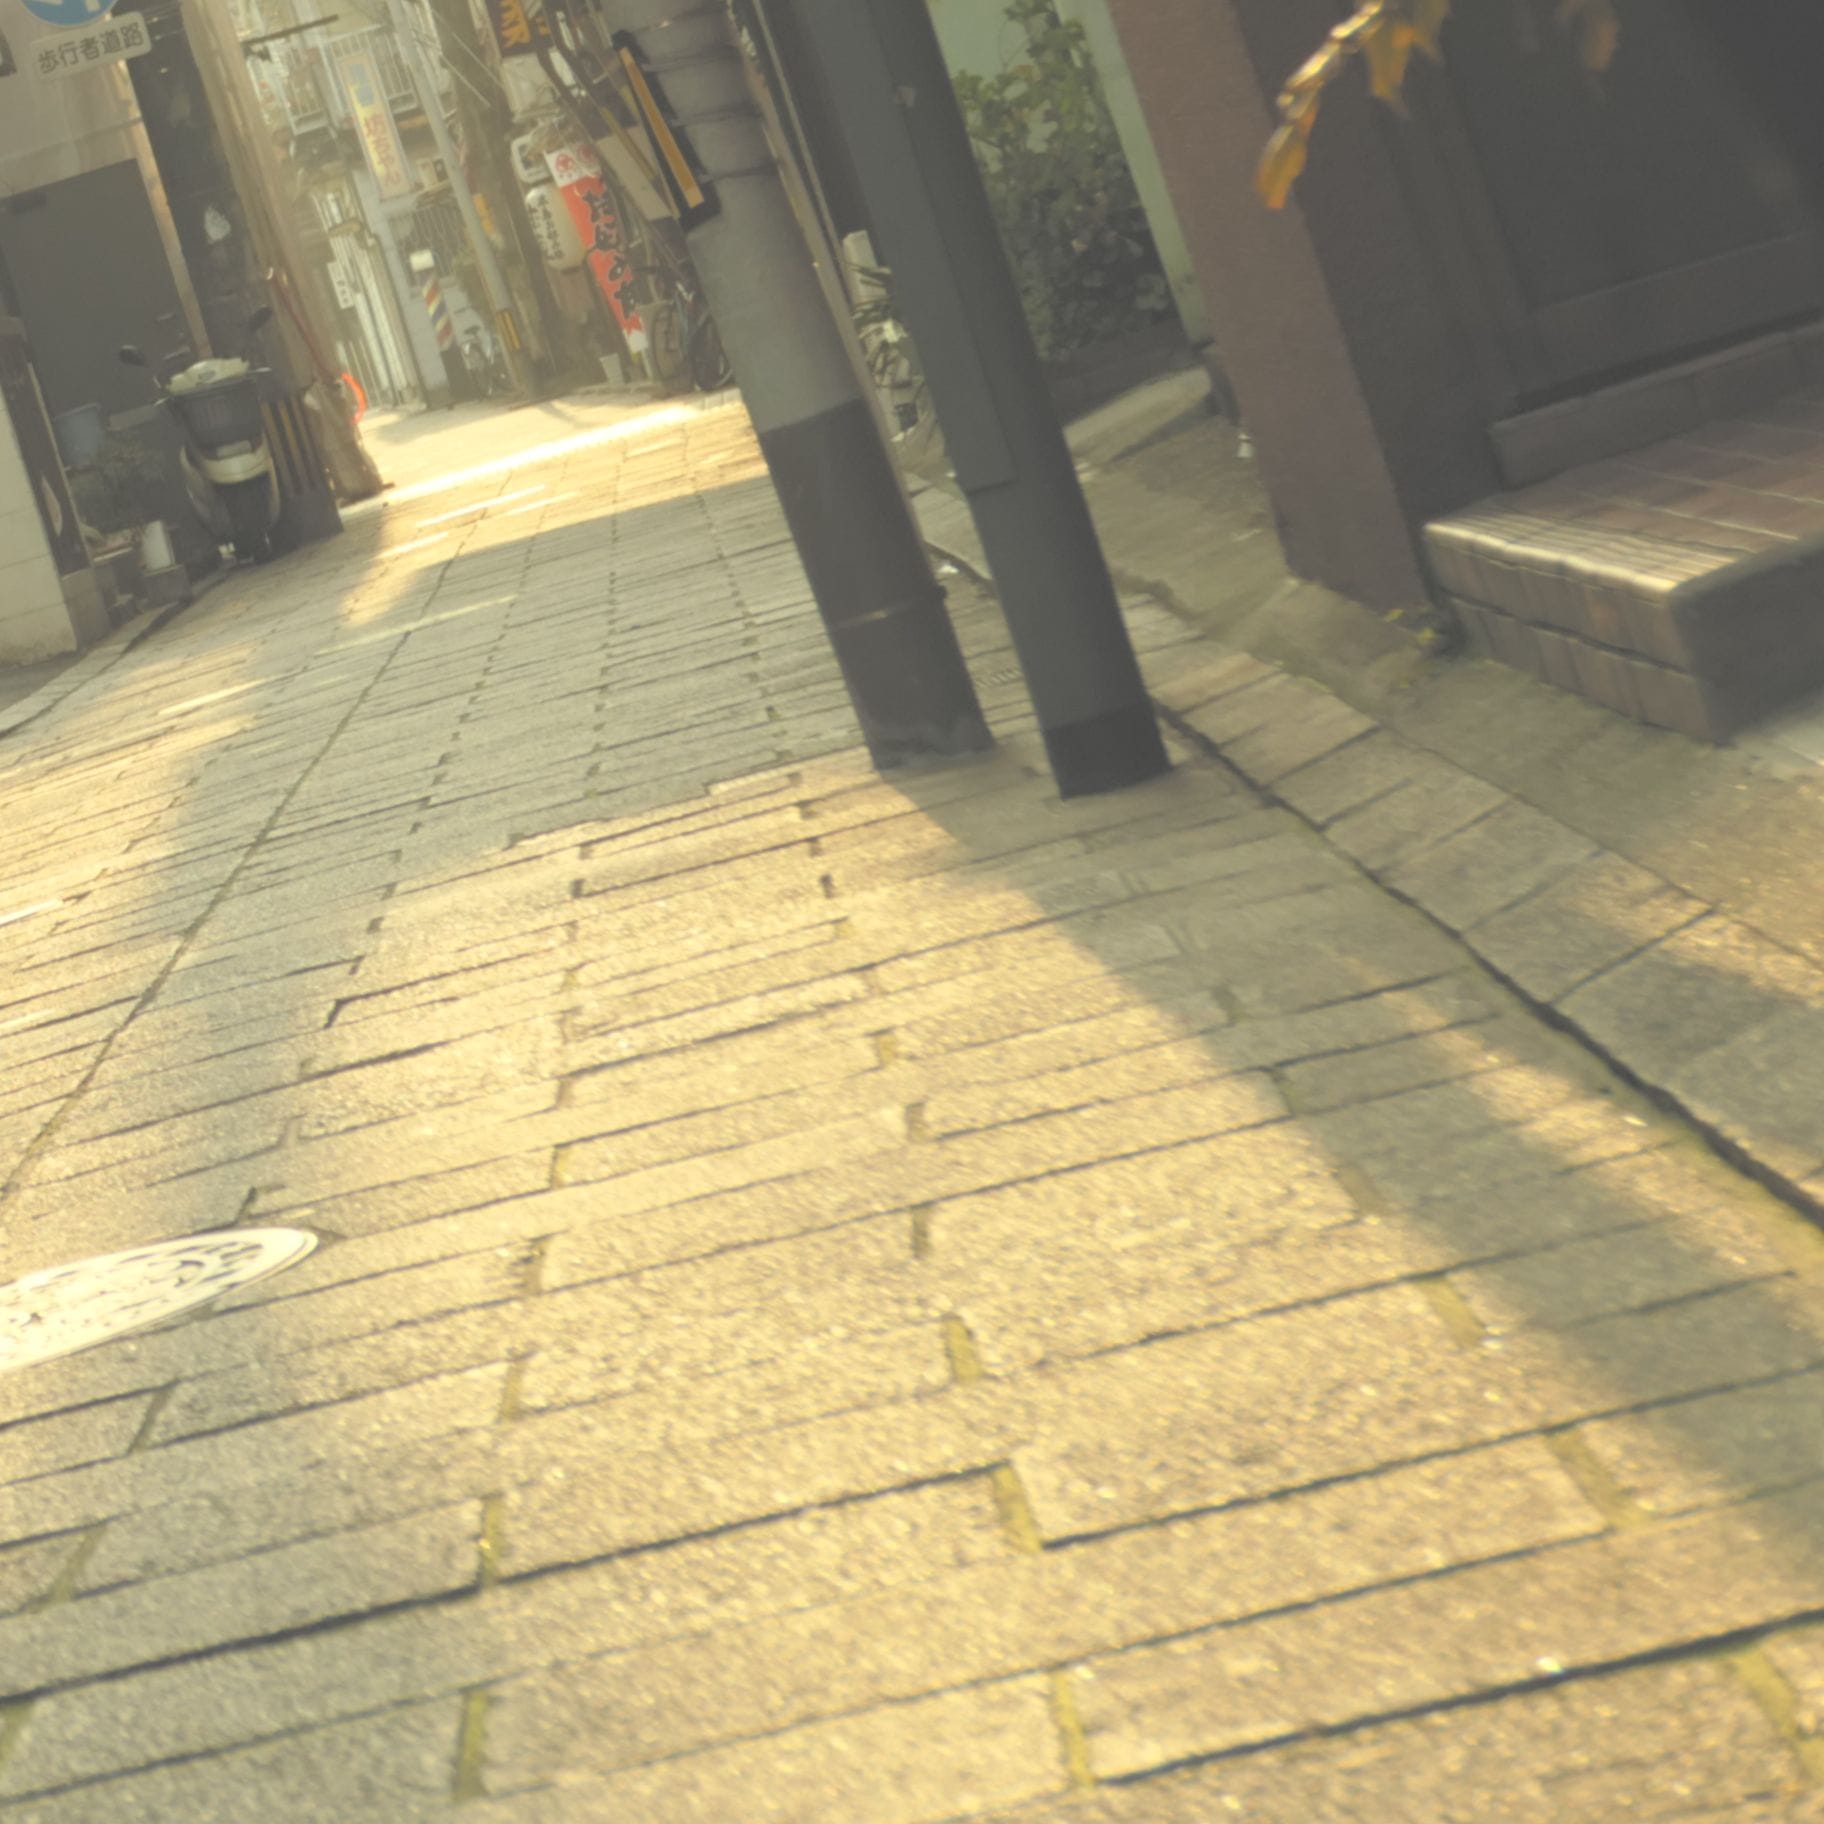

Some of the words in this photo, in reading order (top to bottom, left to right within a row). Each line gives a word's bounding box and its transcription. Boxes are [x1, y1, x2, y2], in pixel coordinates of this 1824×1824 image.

[37, 22, 145, 74] 歩行者道路
